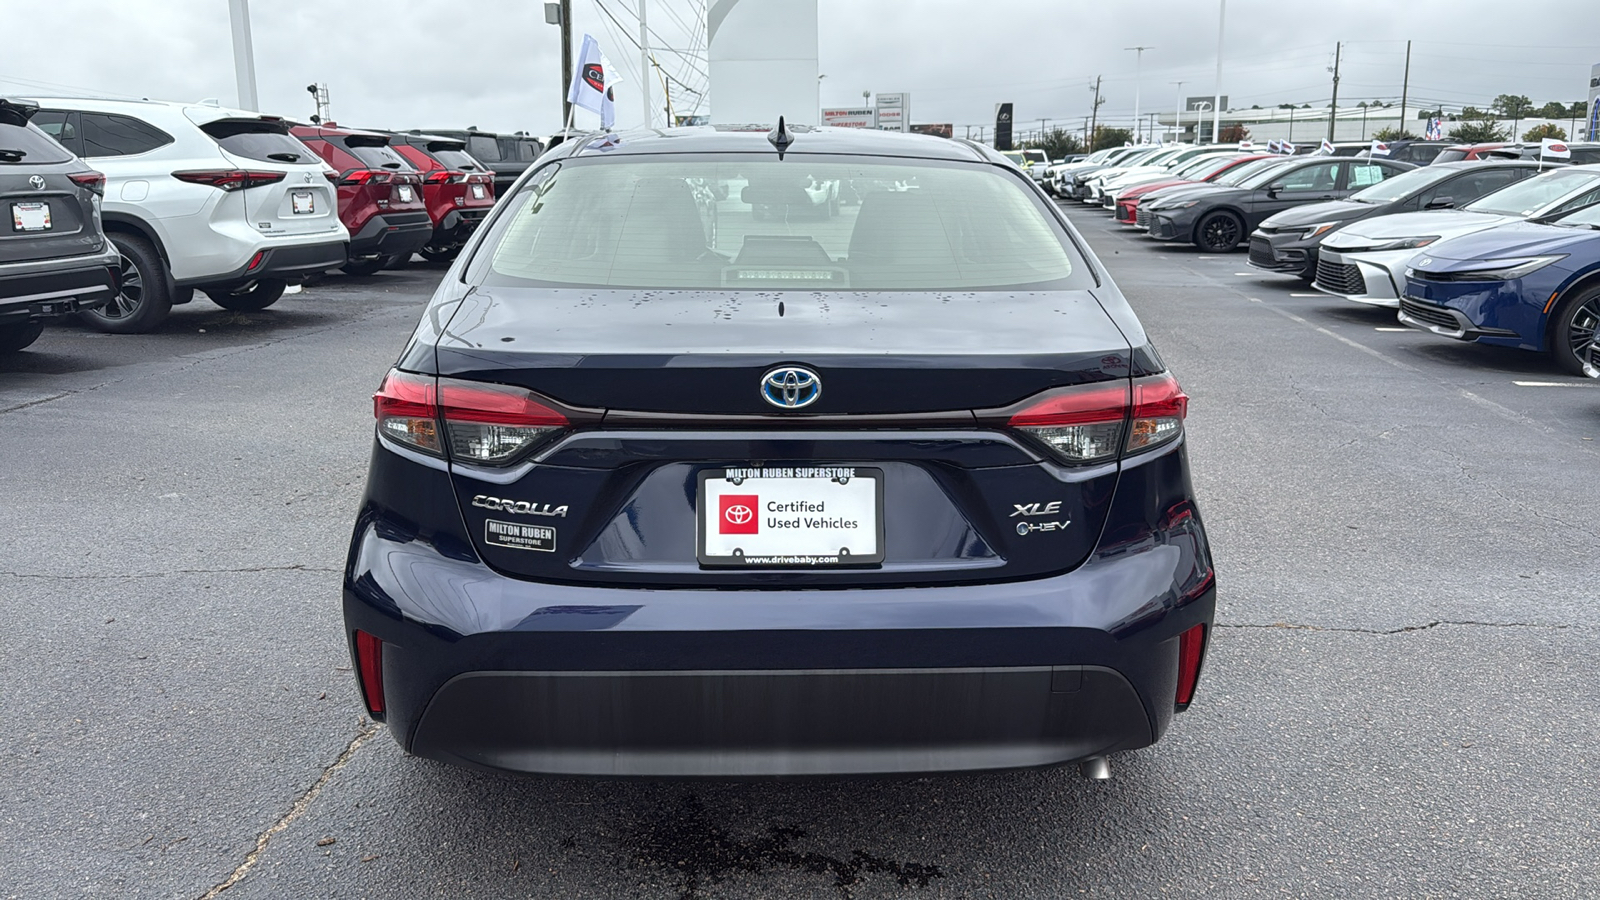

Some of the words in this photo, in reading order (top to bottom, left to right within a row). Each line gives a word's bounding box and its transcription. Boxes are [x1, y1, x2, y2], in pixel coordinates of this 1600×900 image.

[725, 467, 761, 478] MILTON
[762, 467, 794, 478] RUBEN
[795, 467, 856, 478] SUPERSTORE
[471, 494, 569, 518] COROLLA
[767, 501, 825, 513] Certified
[1008, 500, 1063, 518] XLE
[767, 517, 800, 529] Used
[804, 517, 858, 529] Vehicles
[488, 521, 520, 537] MILTON
[521, 526, 552, 540] RUBEN
[498, 534, 542, 546] SUPERSTORE
[744, 555, 839, 565] www.drivebaby.com
